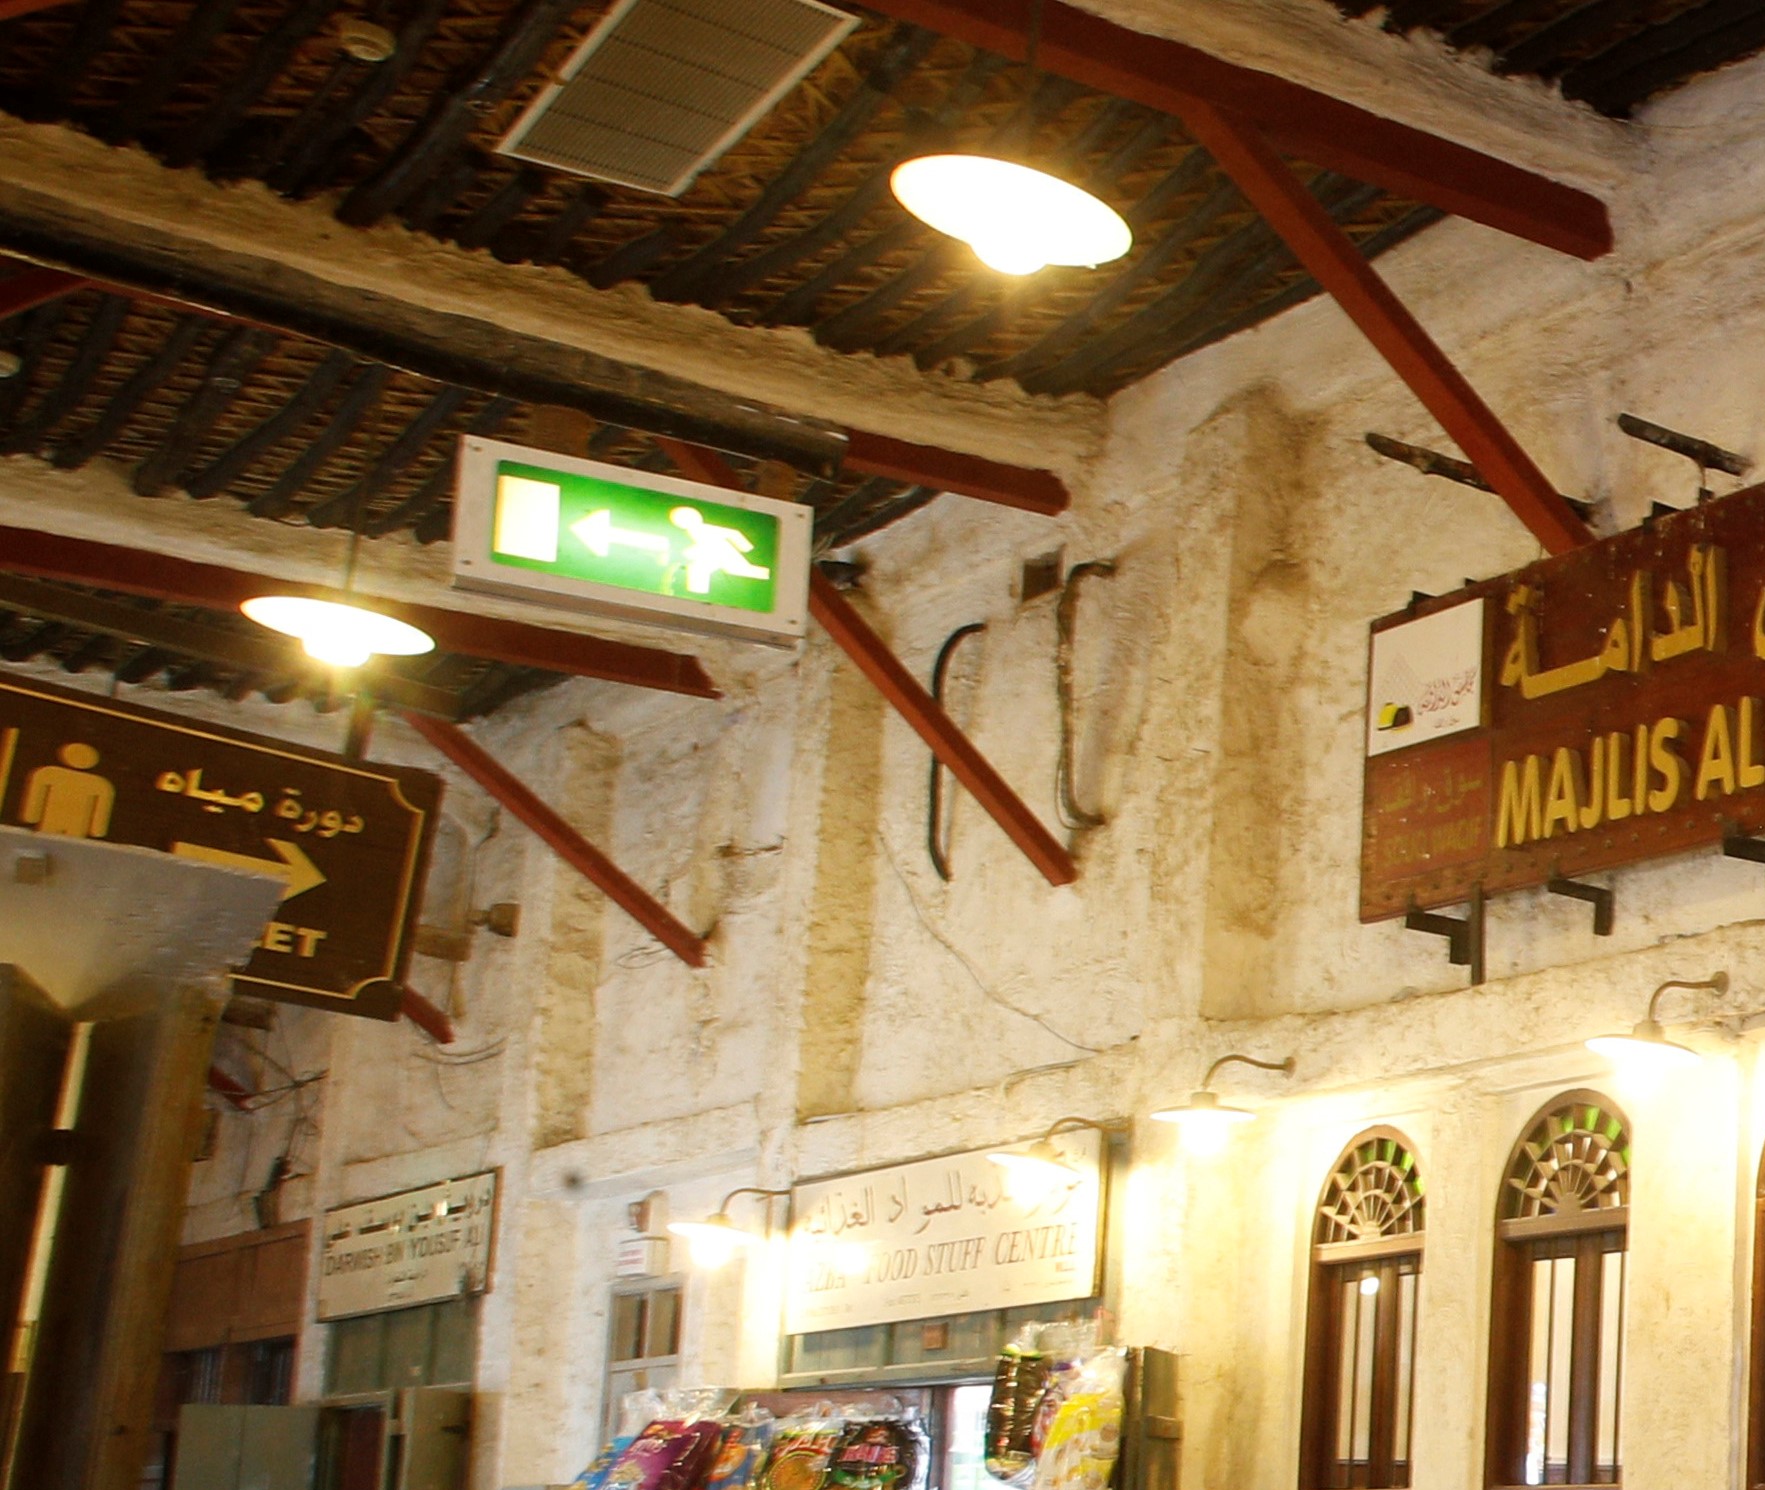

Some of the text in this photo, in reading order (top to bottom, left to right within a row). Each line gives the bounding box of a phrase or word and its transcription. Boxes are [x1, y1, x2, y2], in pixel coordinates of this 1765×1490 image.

[1500, 542, 1727, 699] الدامة
[157, 766, 364, 838] دورة مياه
[1497, 715, 1689, 847] MAJLIS
[924, 1236, 986, 1276] STUFF
